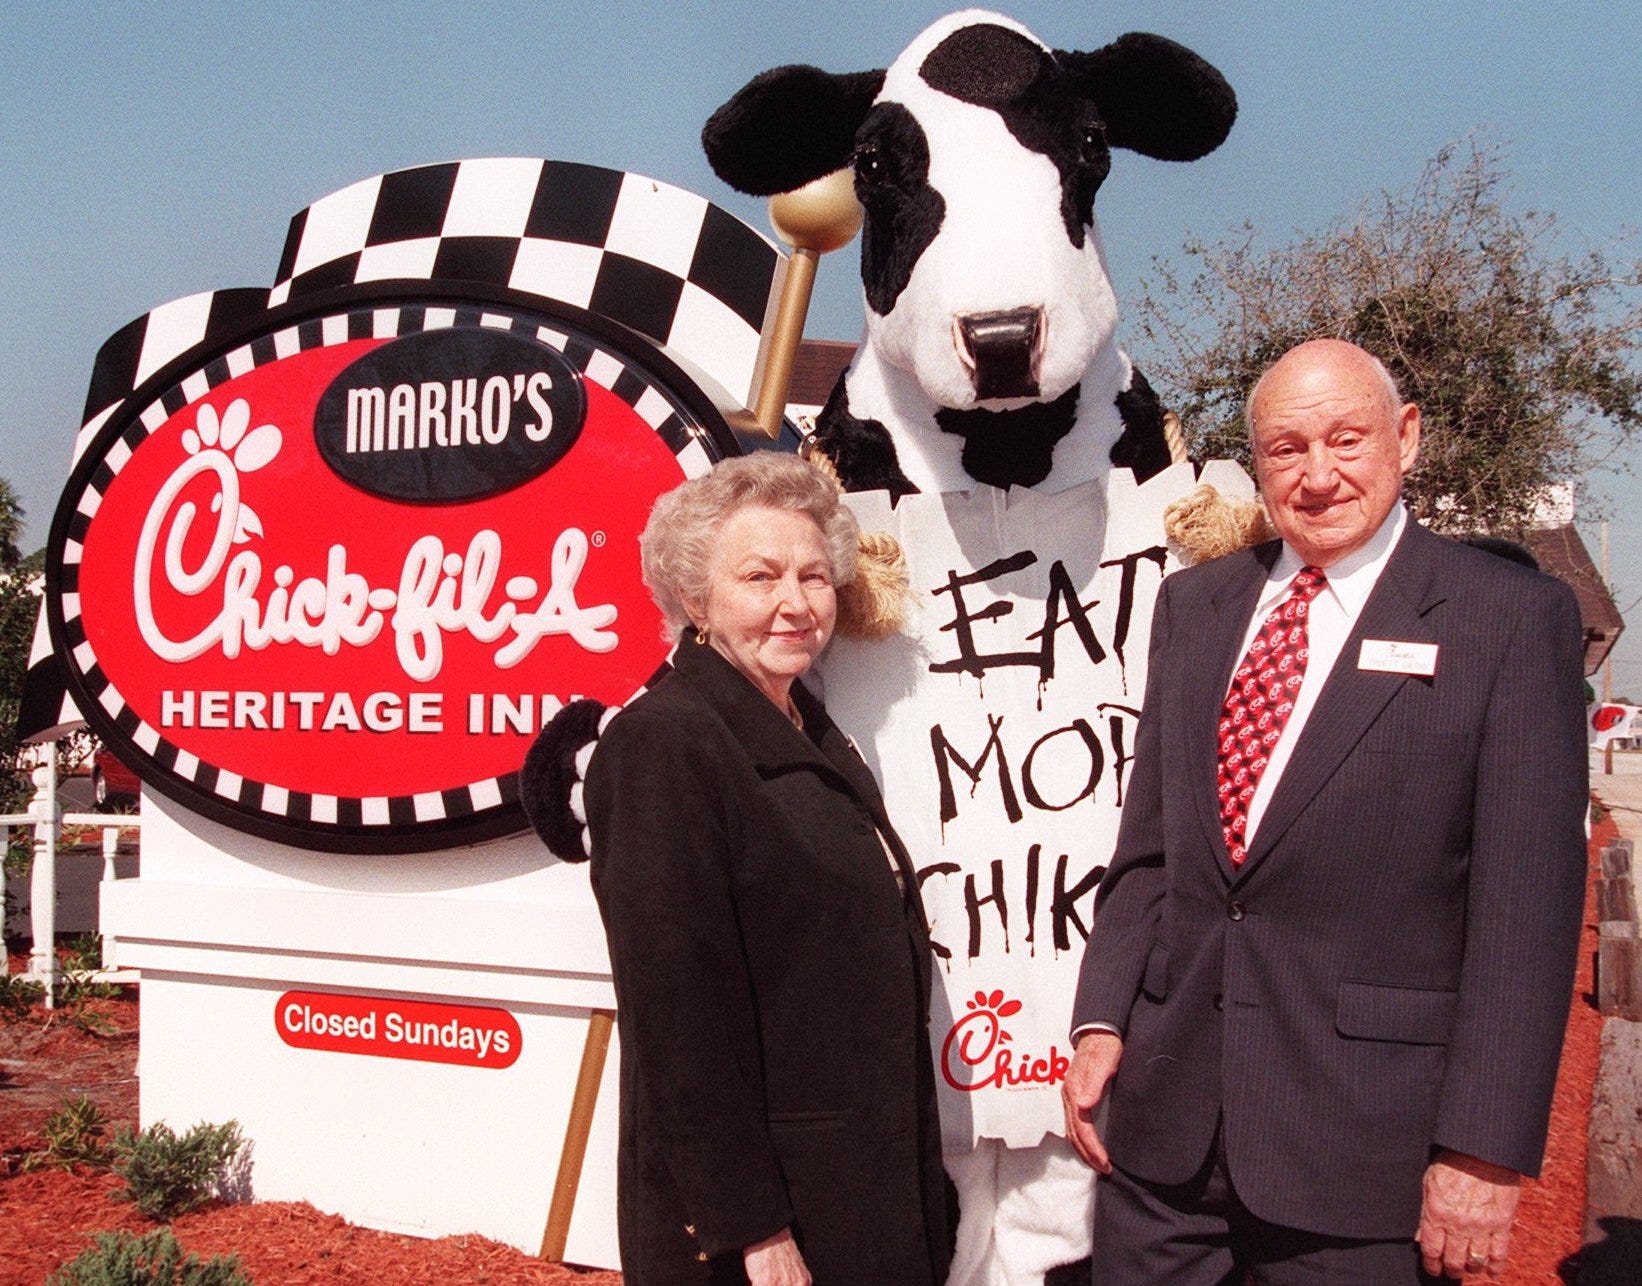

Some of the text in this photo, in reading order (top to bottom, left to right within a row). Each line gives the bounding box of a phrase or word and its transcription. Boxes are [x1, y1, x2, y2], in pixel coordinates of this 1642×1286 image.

[346, 372, 553, 453] MARKO'S
[133, 447, 620, 682] Chick-fil-A
[928, 548, 1168, 690] EAT
[162, 690, 443, 733] HERITAGE
[284, 1003, 510, 1058] Closed Sundays
